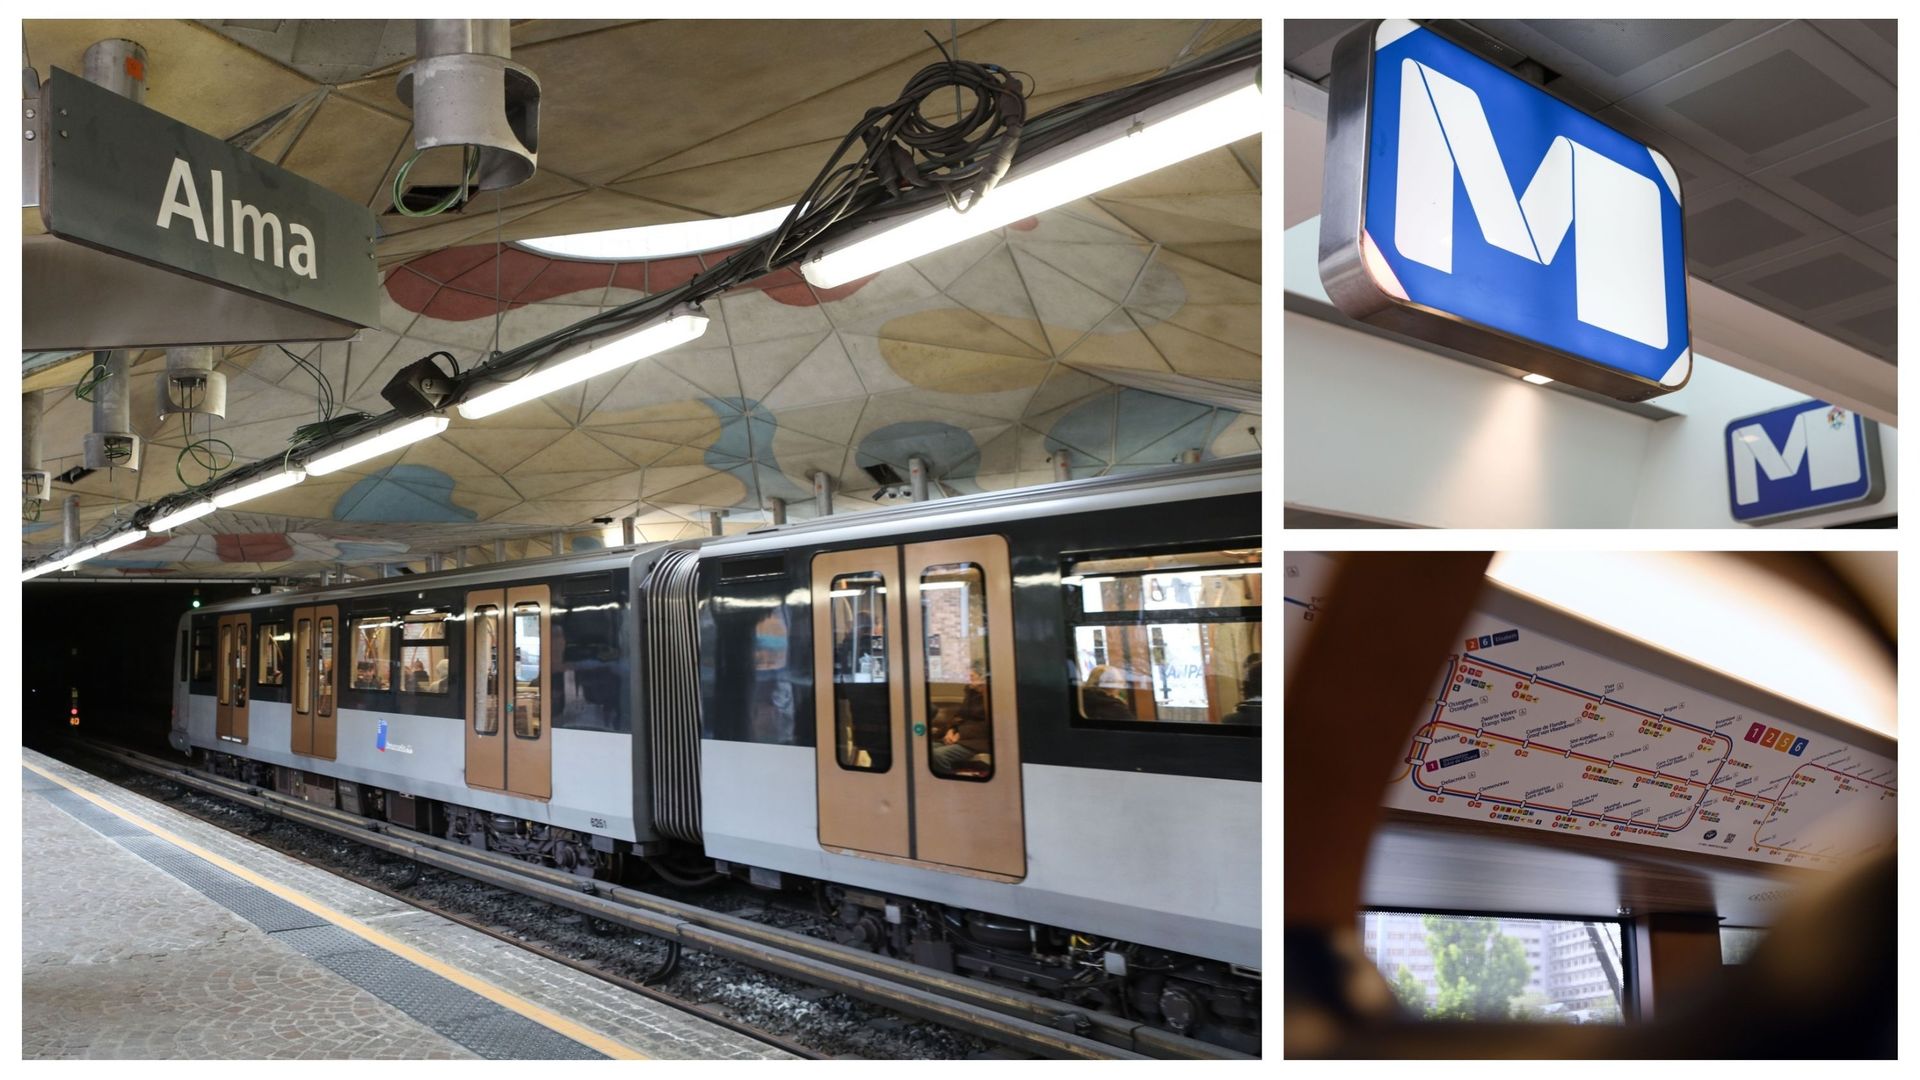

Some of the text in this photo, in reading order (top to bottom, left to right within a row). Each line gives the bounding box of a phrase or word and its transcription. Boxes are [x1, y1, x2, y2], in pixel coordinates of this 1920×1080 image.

[156, 157, 319, 280] Alma
[1394, 58, 1669, 350] M
[1730, 405, 1862, 506] M
[1535, 660, 1565, 672] Ribaucourt
[1752, 728, 1802, 752] 1 2 5 6
